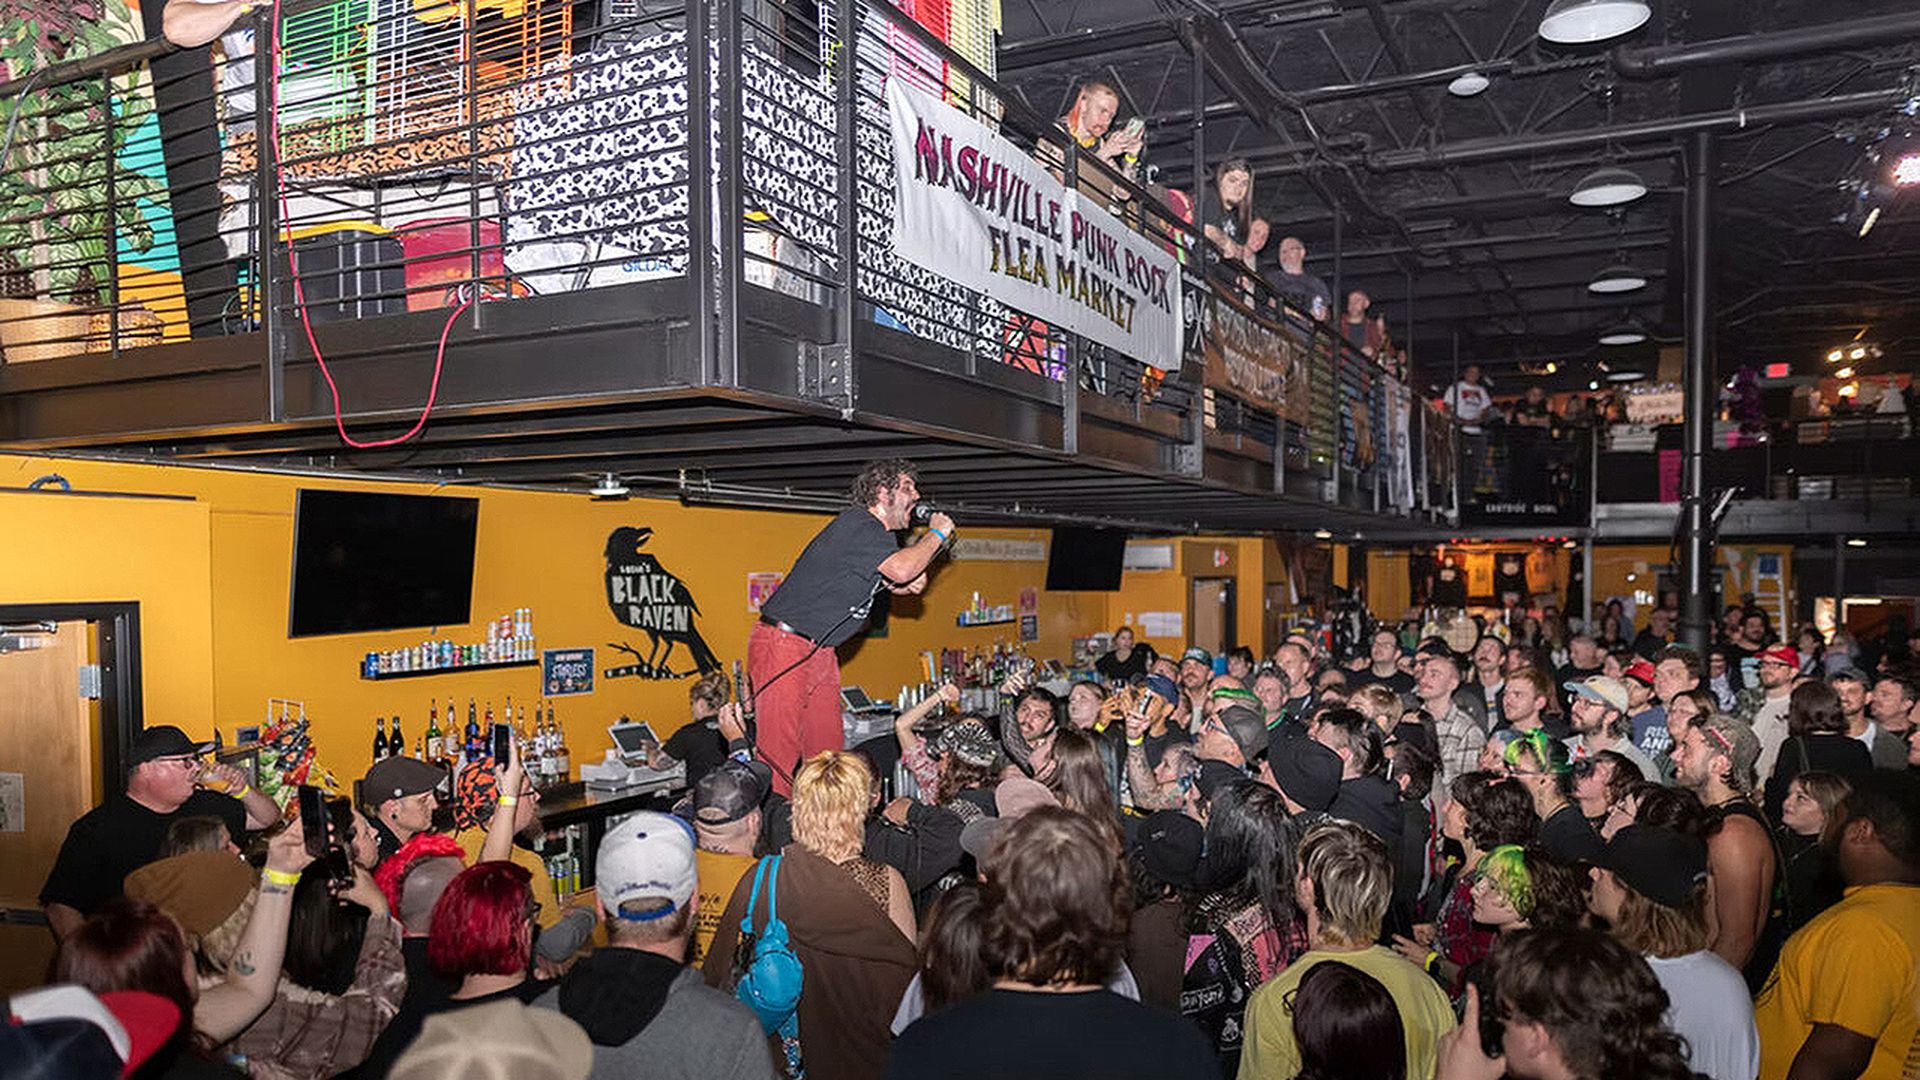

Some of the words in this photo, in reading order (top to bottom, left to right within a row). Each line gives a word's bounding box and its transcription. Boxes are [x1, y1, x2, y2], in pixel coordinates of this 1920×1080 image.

[914, 117, 1063, 243] NASHVILLE
[1071, 210, 1120, 280] PUNK
[1124, 247, 1171, 315] ROCK
[988, 225, 1049, 288] FLEA
[1055, 255, 1138, 334] MARKET
[611, 574, 676, 605] BLACK
[629, 605, 689, 632] RAVEN
[1645, 725, 1669, 738] RIS
